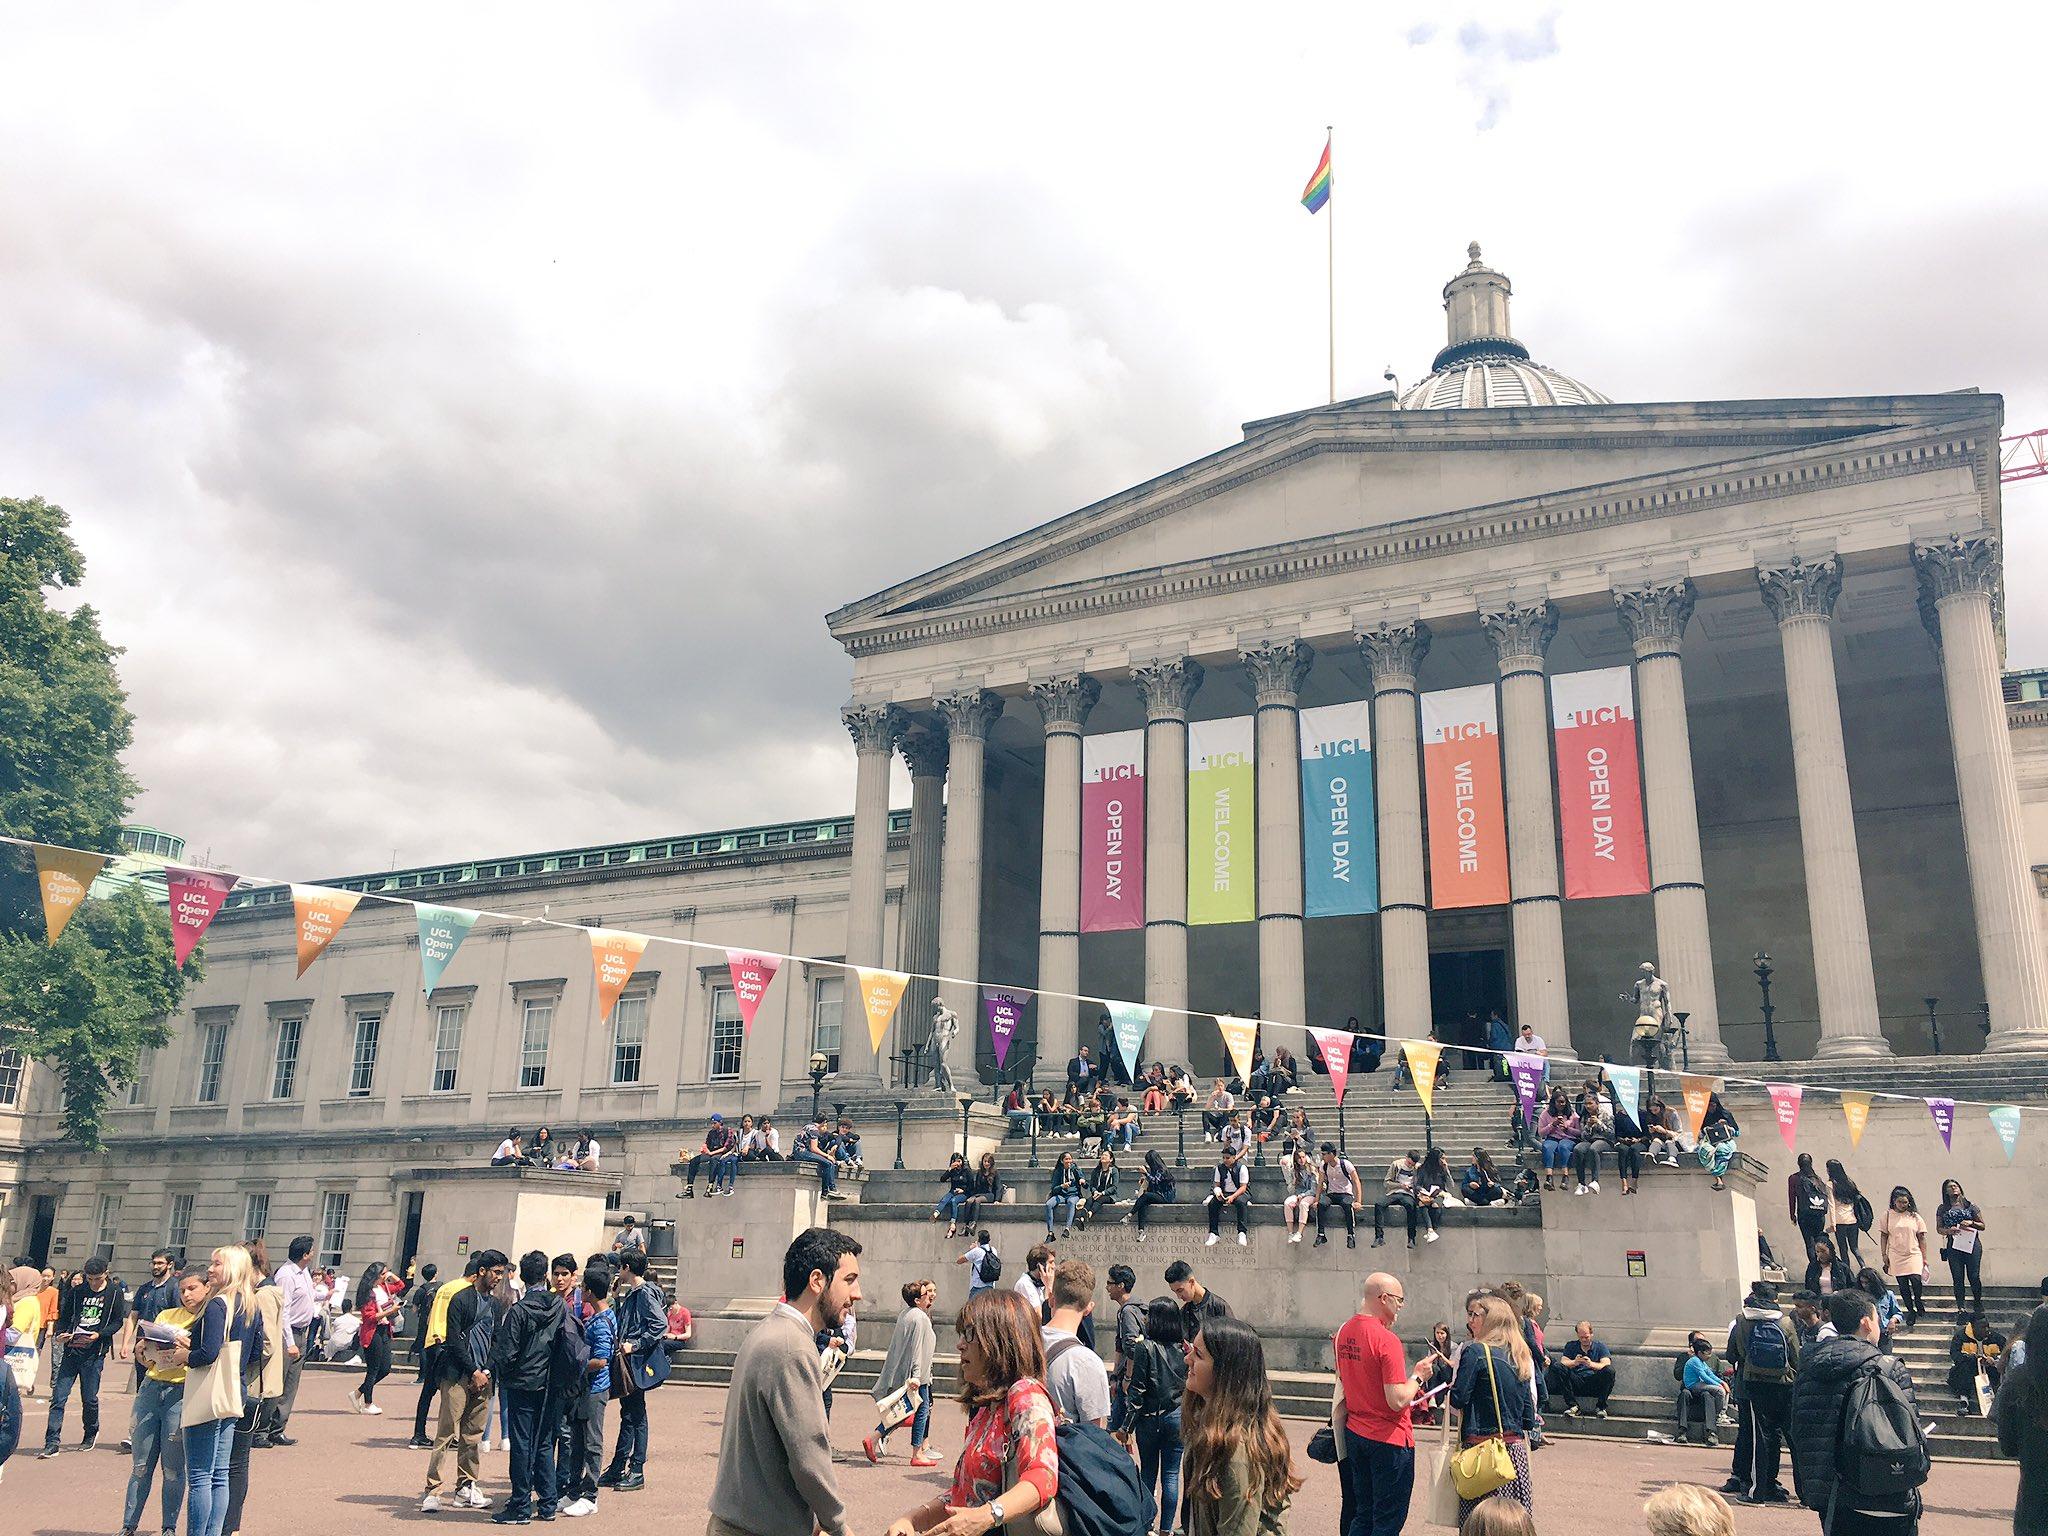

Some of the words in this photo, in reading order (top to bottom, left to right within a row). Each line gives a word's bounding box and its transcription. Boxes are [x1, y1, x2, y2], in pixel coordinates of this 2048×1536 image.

[1575, 705, 1630, 726] UCL
[1444, 722, 1494, 741] UCL
[1320, 738, 1367, 758] UCL
[1207, 752, 1250, 768] UCL
[1101, 764, 1142, 781] UCL
[1586, 747, 1611, 811] OPEN
[1329, 776, 1348, 835] OPEN
[1454, 760, 1478, 873] WELCOME
[1106, 800, 1123, 856] OPEN
[1214, 787, 1230, 892] WELCOME
[1592, 815, 1616, 862] DAY
[1332, 840, 1350, 883] DAY
[1106, 860, 1122, 901] DAY
[47, 882, 80, 894] Open
[49, 893, 74, 906] Day
[183, 892, 209, 905] UCL
[177, 903, 210, 916] Open
[179, 914, 203, 928] Day
[309, 911, 332, 924] UCL
[302, 921, 332, 935] Open
[430, 927, 453, 940] UCL
[303, 932, 326, 946] Day
[425, 937, 453, 950] Open
[426, 948, 448, 961] Day
[604, 954, 625, 965] UCL
[600, 963, 627, 975] Open
[602, 973, 623, 985] Day
[741, 971, 761, 982] UCL
[738, 980, 762, 991] Open
[740, 991, 758, 1002] Day
[872, 987, 891, 997] UCL
[869, 997, 892, 1007] Open
[871, 1006, 888, 1017] Day
[996, 1006, 1014, 1016] UCL
[993, 1015, 1014, 1026] Open
[995, 1024, 1011, 1035] Day
[1121, 1023, 1138, 1033] UCL
[1119, 1031, 1140, 1042] Open
[1122, 1040, 1137, 1051] Day
[1327, 1046, 1343, 1056] UCL
[1327, 1054, 1345, 1065] Open
[1330, 1062, 1344, 1073] Day
[1415, 1061, 1430, 1070] UCL
[1518, 1072, 1533, 1081] UCL
[1518, 1079, 1535, 1089] Open
[1618, 1079, 1633, 1088] UCL
[1520, 1088, 1534, 1099] Day
[1688, 1097, 1705, 1107] Open
[1778, 1100, 1793, 1109] UCL
[1777, 1108, 1795, 1118] Open
[1935, 1109, 1948, 1117] UCL
[1780, 1115, 1793, 1125] Day
[1935, 1117, 1950, 1125] Open
[1999, 1120, 2013, 1129] UCL
[1157, 1235, 1168, 1243] OF
[1170, 1236, 1186, 1244] THE
[1060, 1244, 1075, 1252] THE
[1079, 1244, 1111, 1253] MEDICAL
[1115, 1245, 1145, 1253] SCHOOL
[1149, 1245, 1169, 1254] WHO
[1171, 1245, 1190, 1254] DIED
[1192, 1246, 1201, 1254] IN
[1203, 1246, 1218, 1255] THE
[1223, 1246, 1255, 1255] SERVICE
[1072, 1253, 1093, 1262] THEIR
[1096, 1254, 1133, 1263] COUNTRY
[1136, 1255, 1168, 1264] DURING
[1191, 1256, 1216, 1265] YEARS
